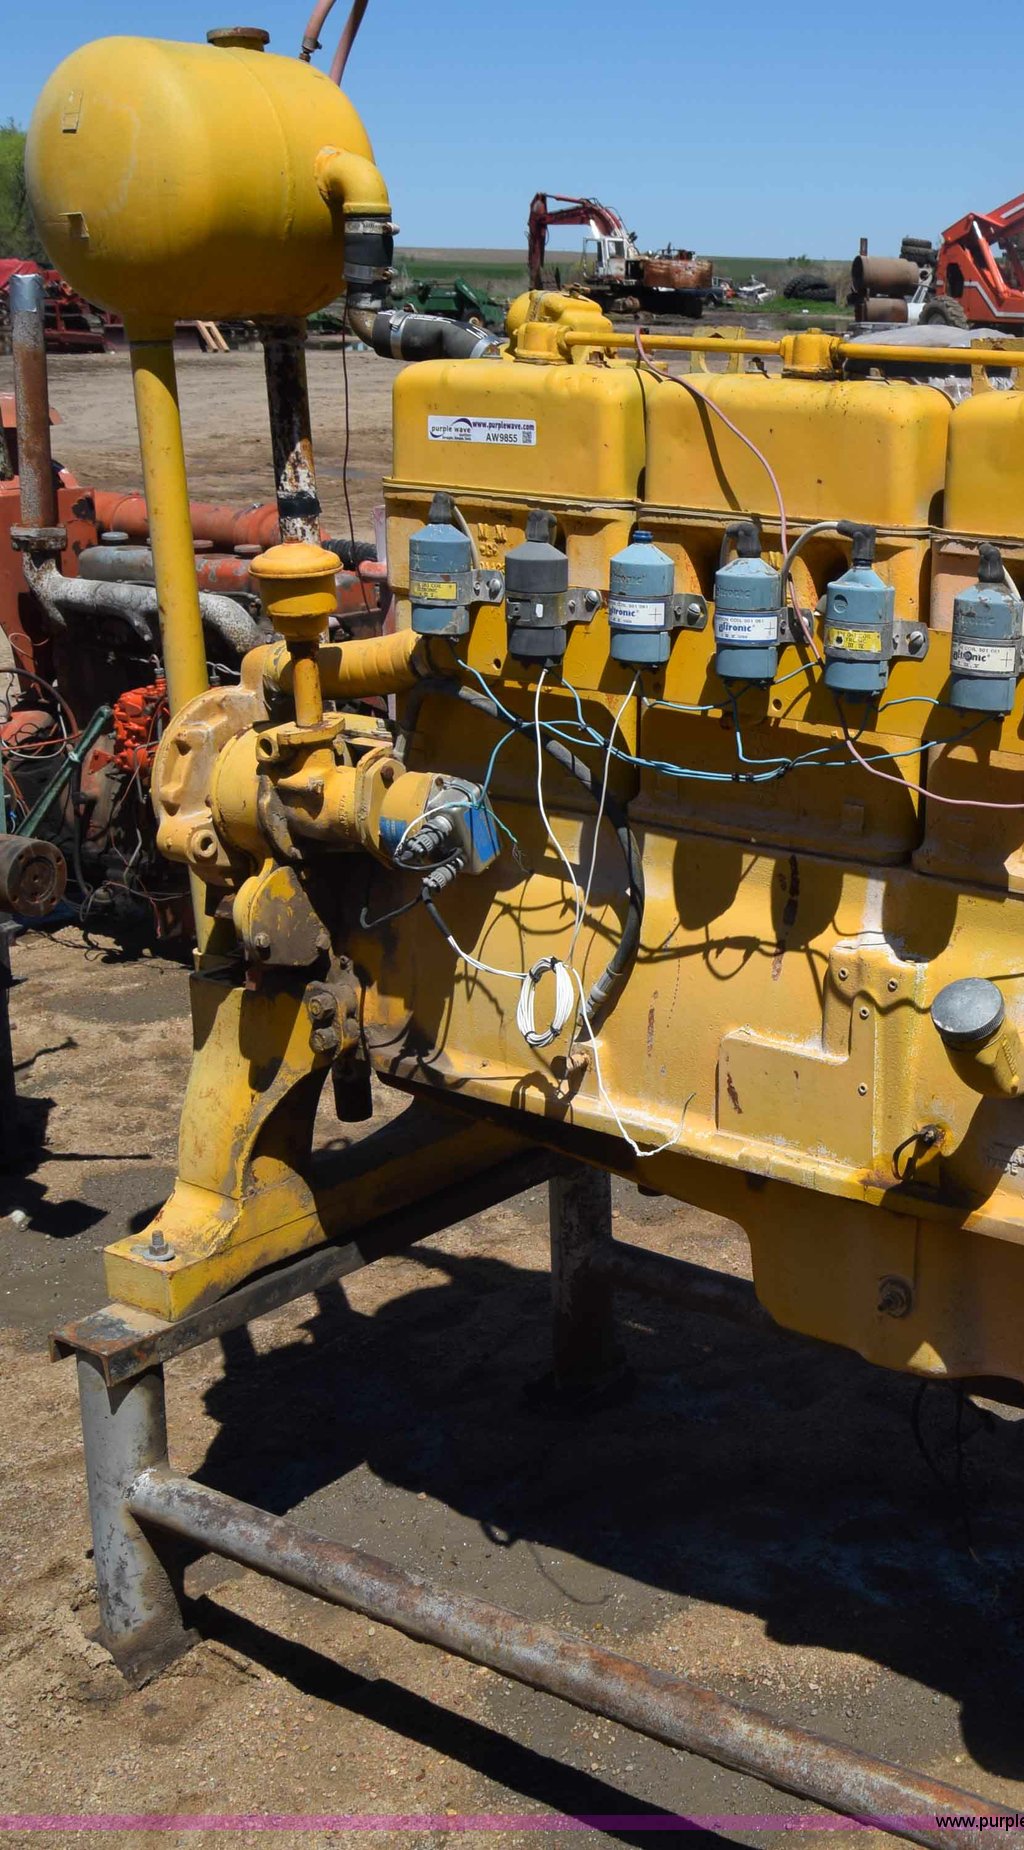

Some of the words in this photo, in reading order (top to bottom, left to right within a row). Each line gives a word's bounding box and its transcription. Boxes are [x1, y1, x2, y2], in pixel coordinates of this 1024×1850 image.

[431, 425, 452, 433] purple
[472, 421, 535, 431] www.purplewave.com
[486, 433, 518, 443] AW9855
